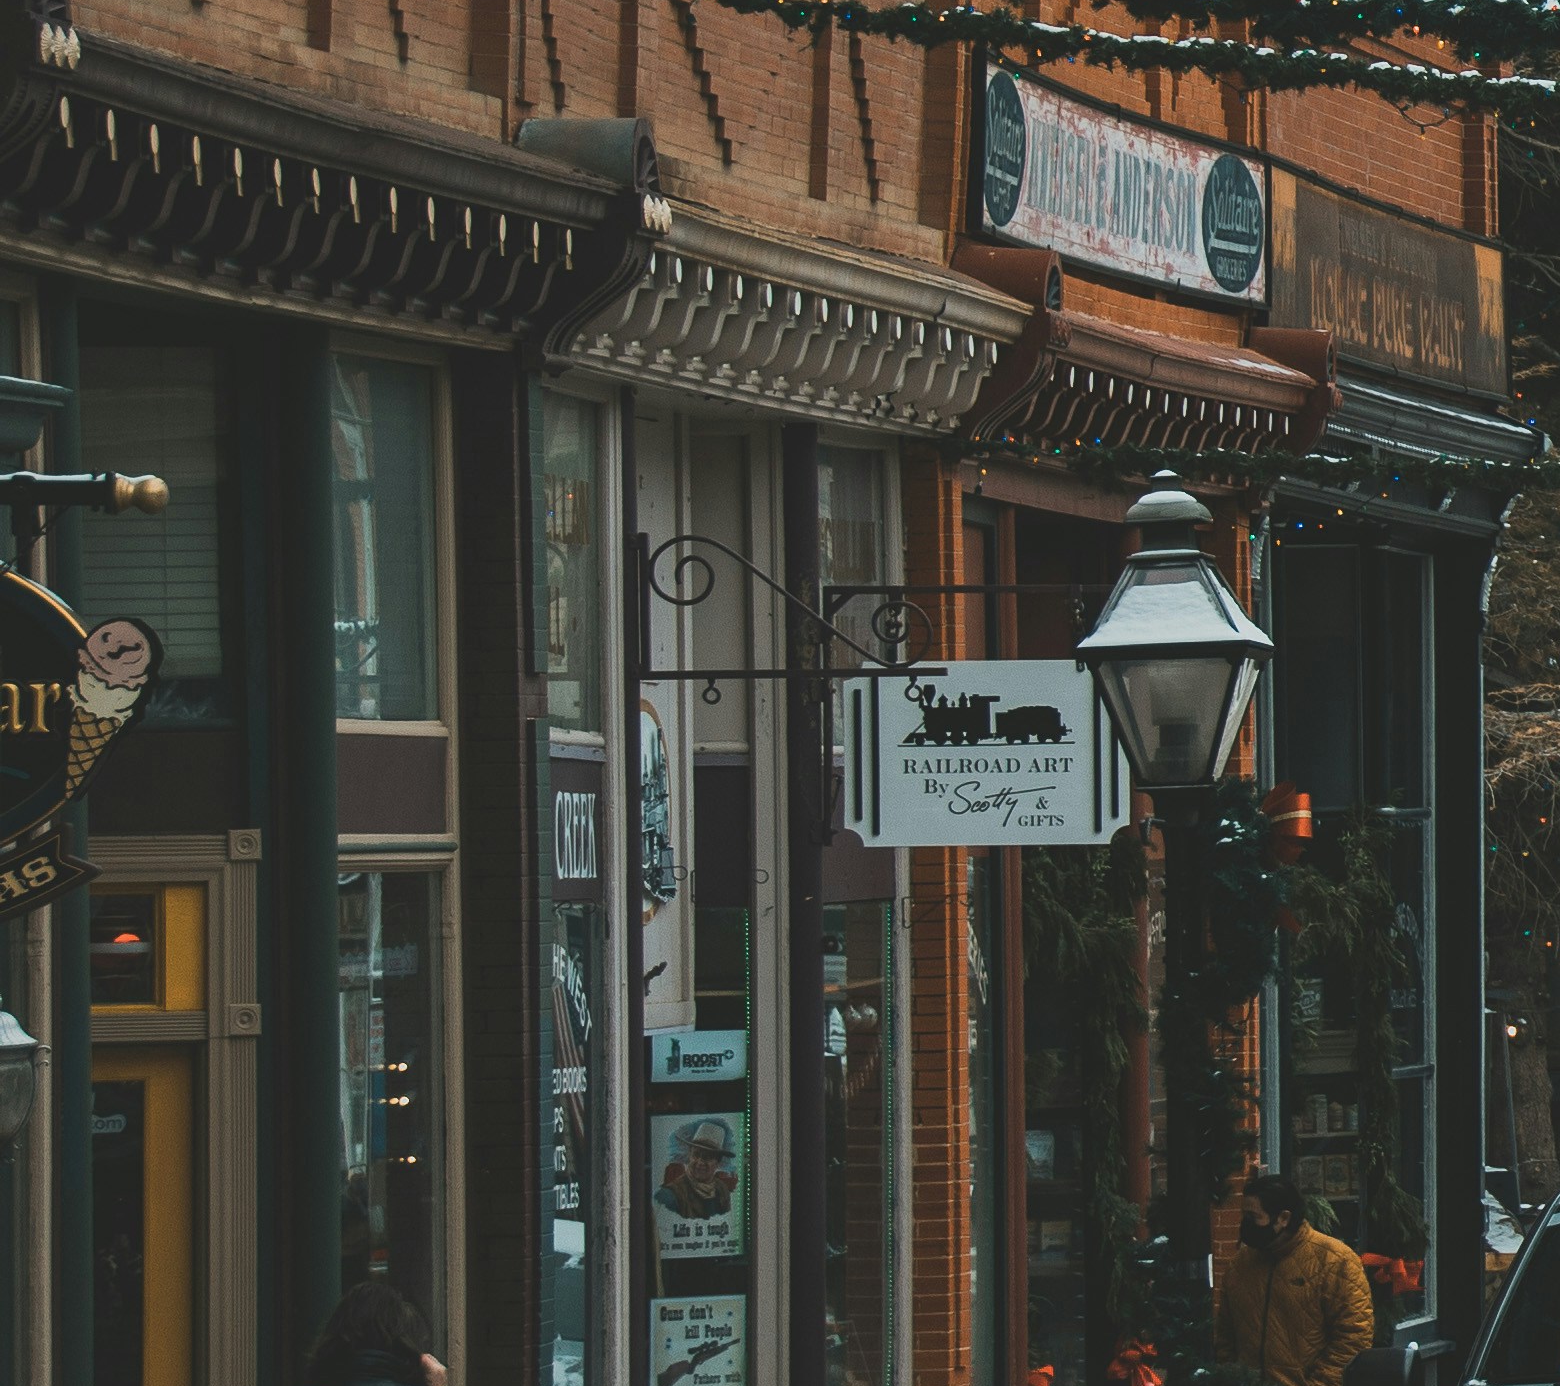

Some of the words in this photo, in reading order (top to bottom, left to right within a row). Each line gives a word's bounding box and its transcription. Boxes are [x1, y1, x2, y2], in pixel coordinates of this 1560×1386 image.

[1111, 147, 1197, 255] ANDERSON
[1208, 166, 1261, 236] Solitaire
[902, 758, 1022, 775] RAILROAD
[1027, 757, 1074, 774] ART
[923, 778, 949, 798] By
[948, 780, 1056, 827] Scotty
[1035, 796, 1049, 810] &
[1017, 815, 1065, 827] GIFTS
[554, 790, 598, 880] CREEK
[565, 952, 593, 1042] WEST
[673, 1223, 691, 1238] Life
[695, 1222, 704, 1237] is
[660, 1306, 684, 1322] Guns
[689, 1304, 714, 1320] don't
[684, 1325, 700, 1339] kill
[704, 1324, 733, 1341] People
